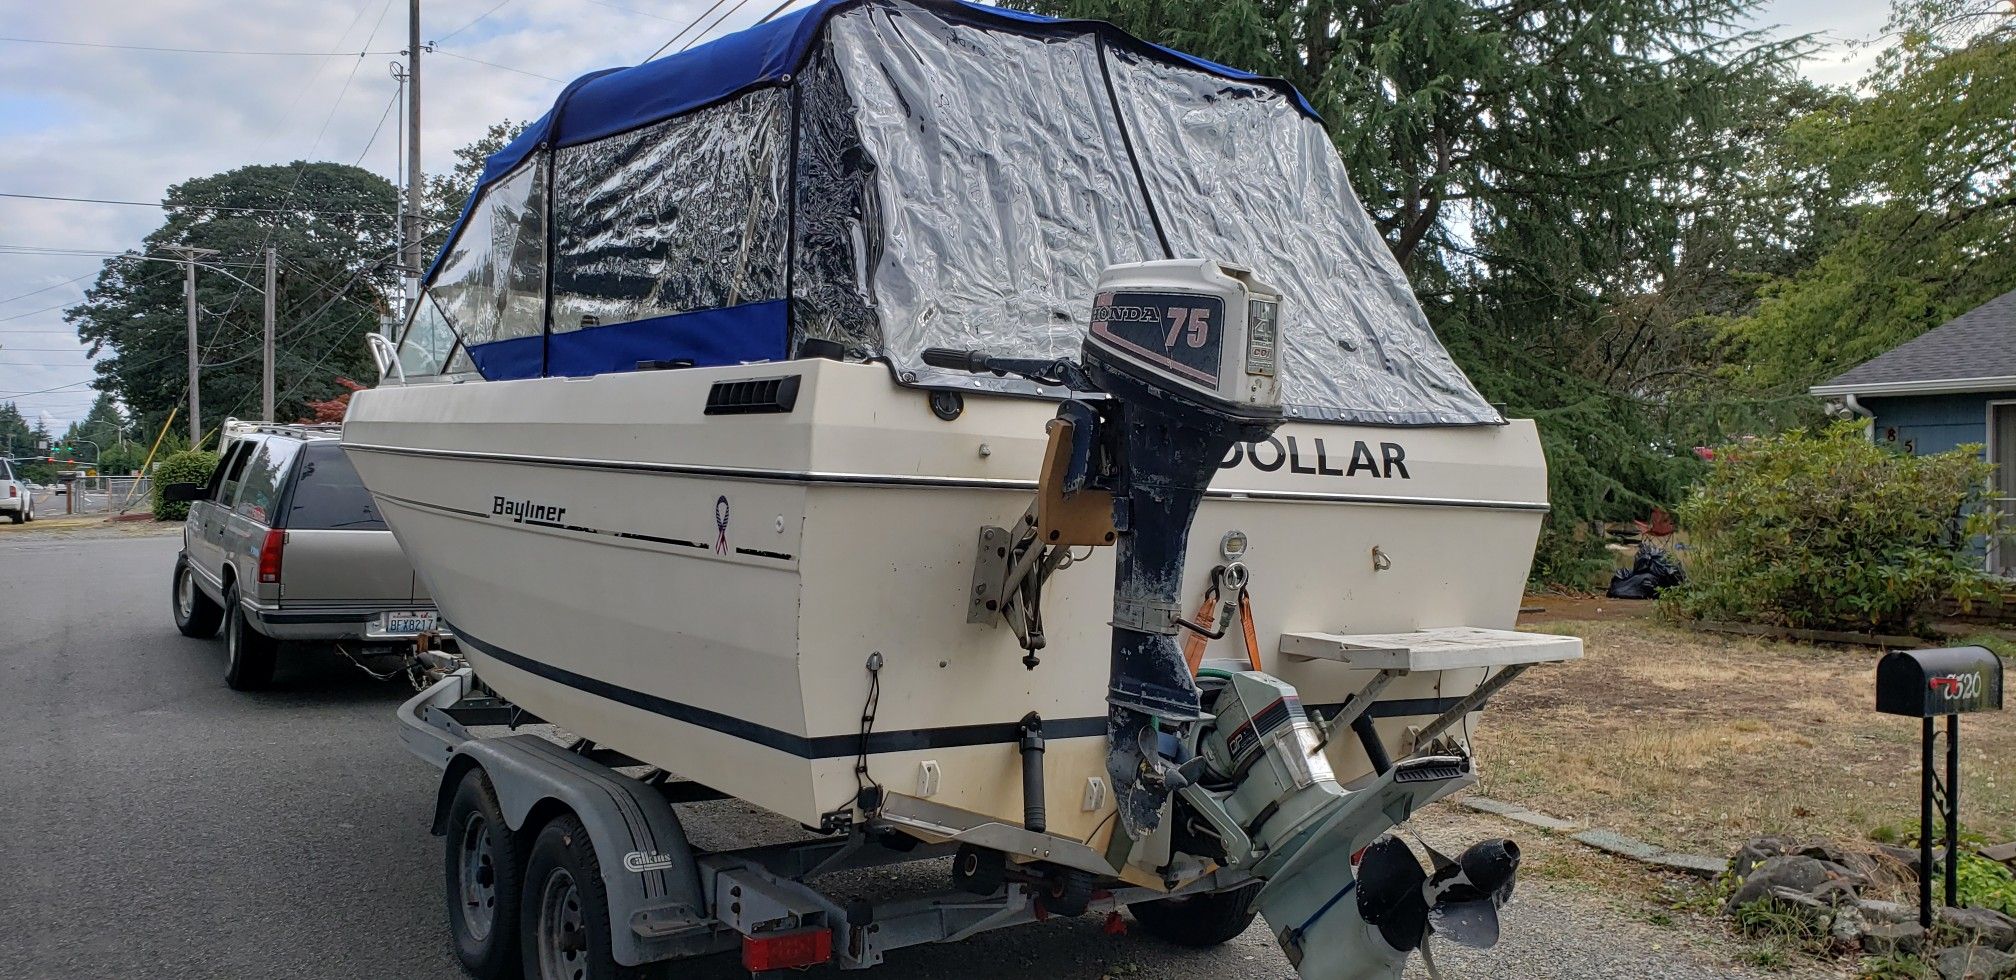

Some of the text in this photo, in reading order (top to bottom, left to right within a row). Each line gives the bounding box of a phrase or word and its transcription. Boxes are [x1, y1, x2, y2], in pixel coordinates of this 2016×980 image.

[1165, 306, 1210, 348] 75
[492, 495, 566, 523] Bayliner
[623, 850, 673, 873] Calkins
